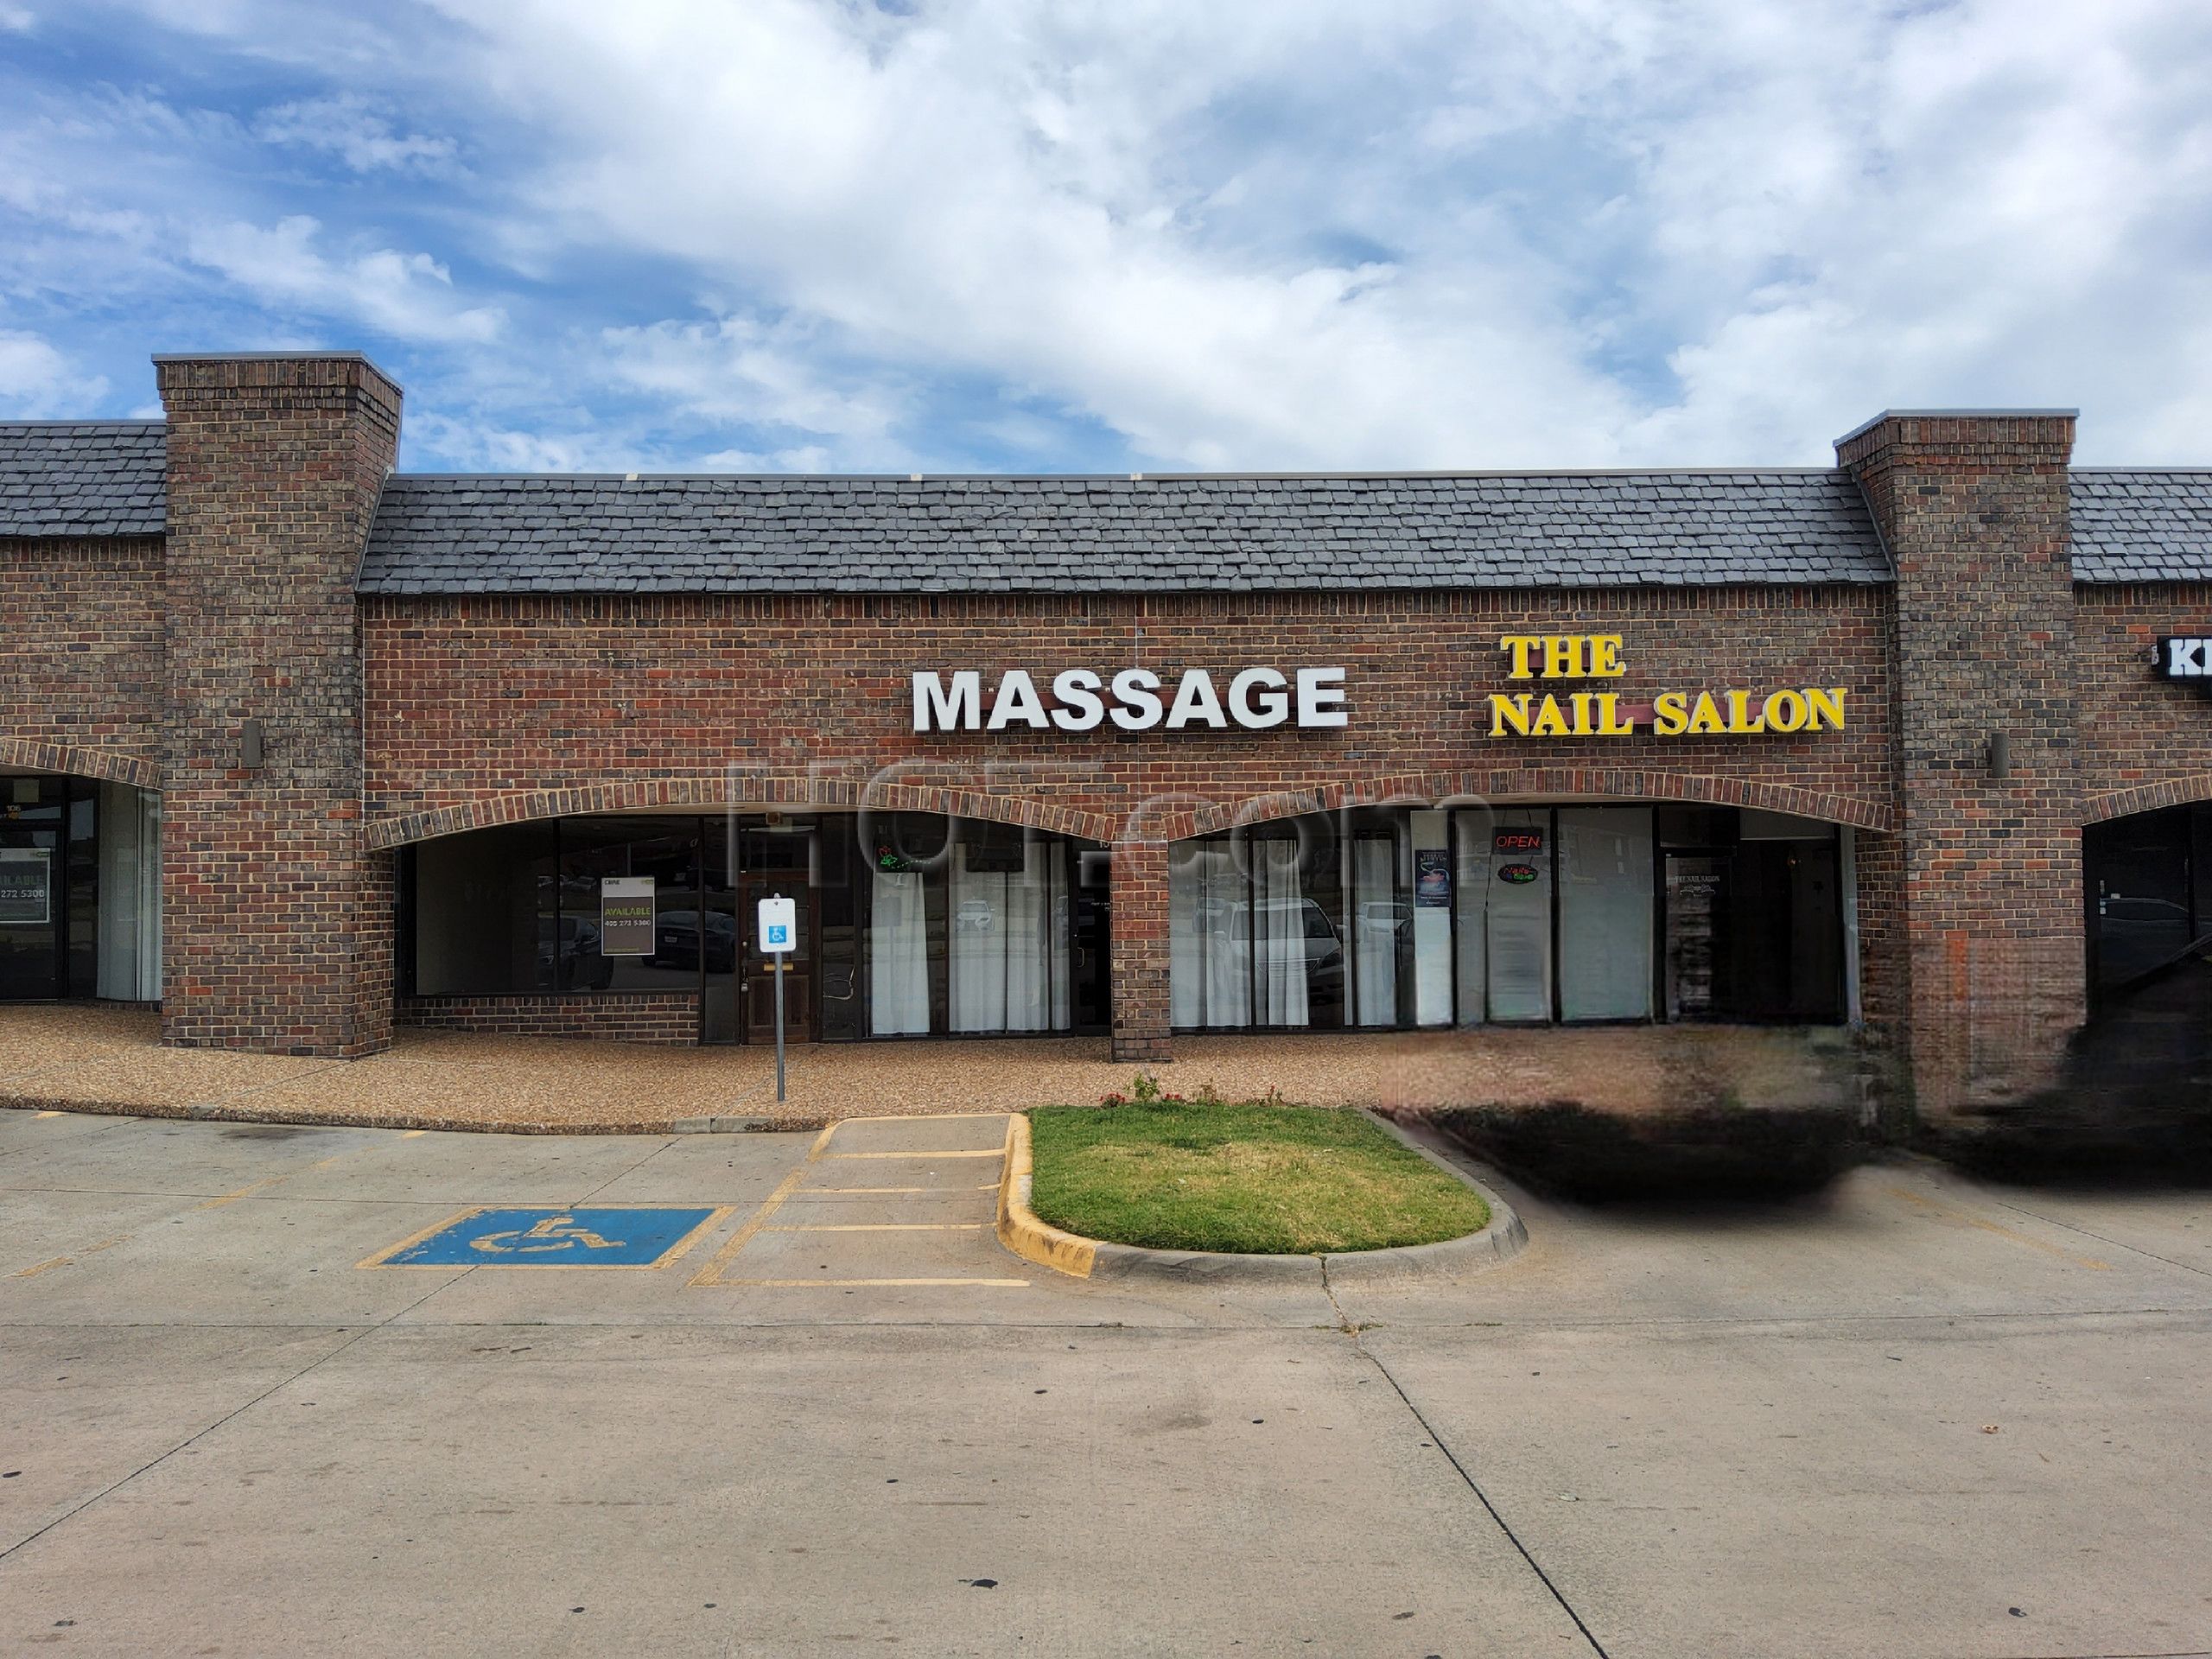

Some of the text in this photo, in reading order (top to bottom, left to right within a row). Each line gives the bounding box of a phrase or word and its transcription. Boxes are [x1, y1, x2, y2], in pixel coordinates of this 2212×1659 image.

[1500, 634, 1626, 679] THE
[912, 667, 1349, 733] MASSAGE
[1488, 688, 1848, 737] NAIL SALON
[1496, 836, 1541, 849] OPEN
[1, 889, 45, 898] 272 5300
[604, 907, 651, 917] AVAILABLE
